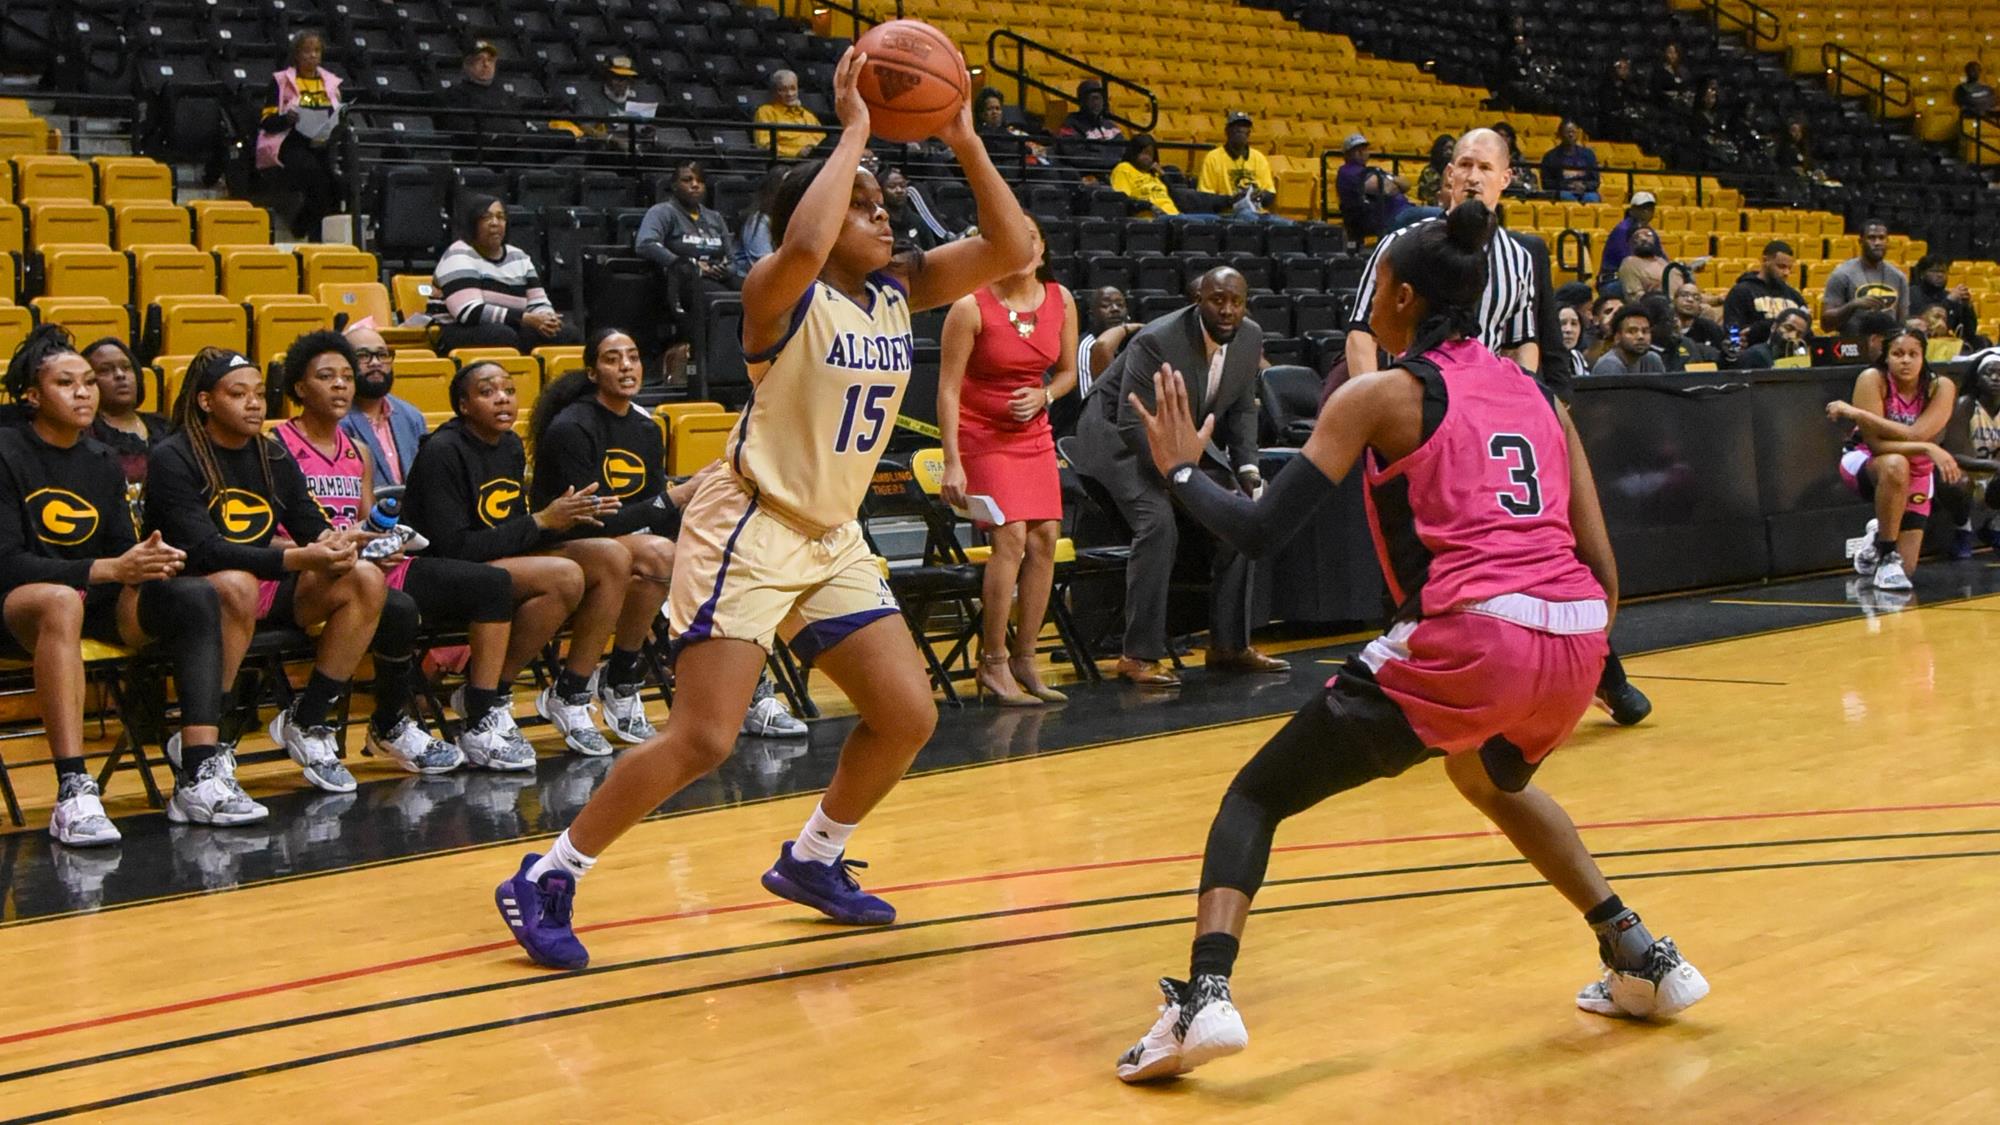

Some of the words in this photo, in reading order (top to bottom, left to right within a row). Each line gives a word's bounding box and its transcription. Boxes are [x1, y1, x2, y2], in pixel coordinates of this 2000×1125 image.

[835, 384, 896, 453] 15
[306, 475, 363, 498] RAMBLIN
[604, 449, 646, 498] G
[1487, 433, 1543, 517] 3
[25, 487, 99, 545] G
[208, 487, 273, 543] G
[478, 478, 520, 528] G
